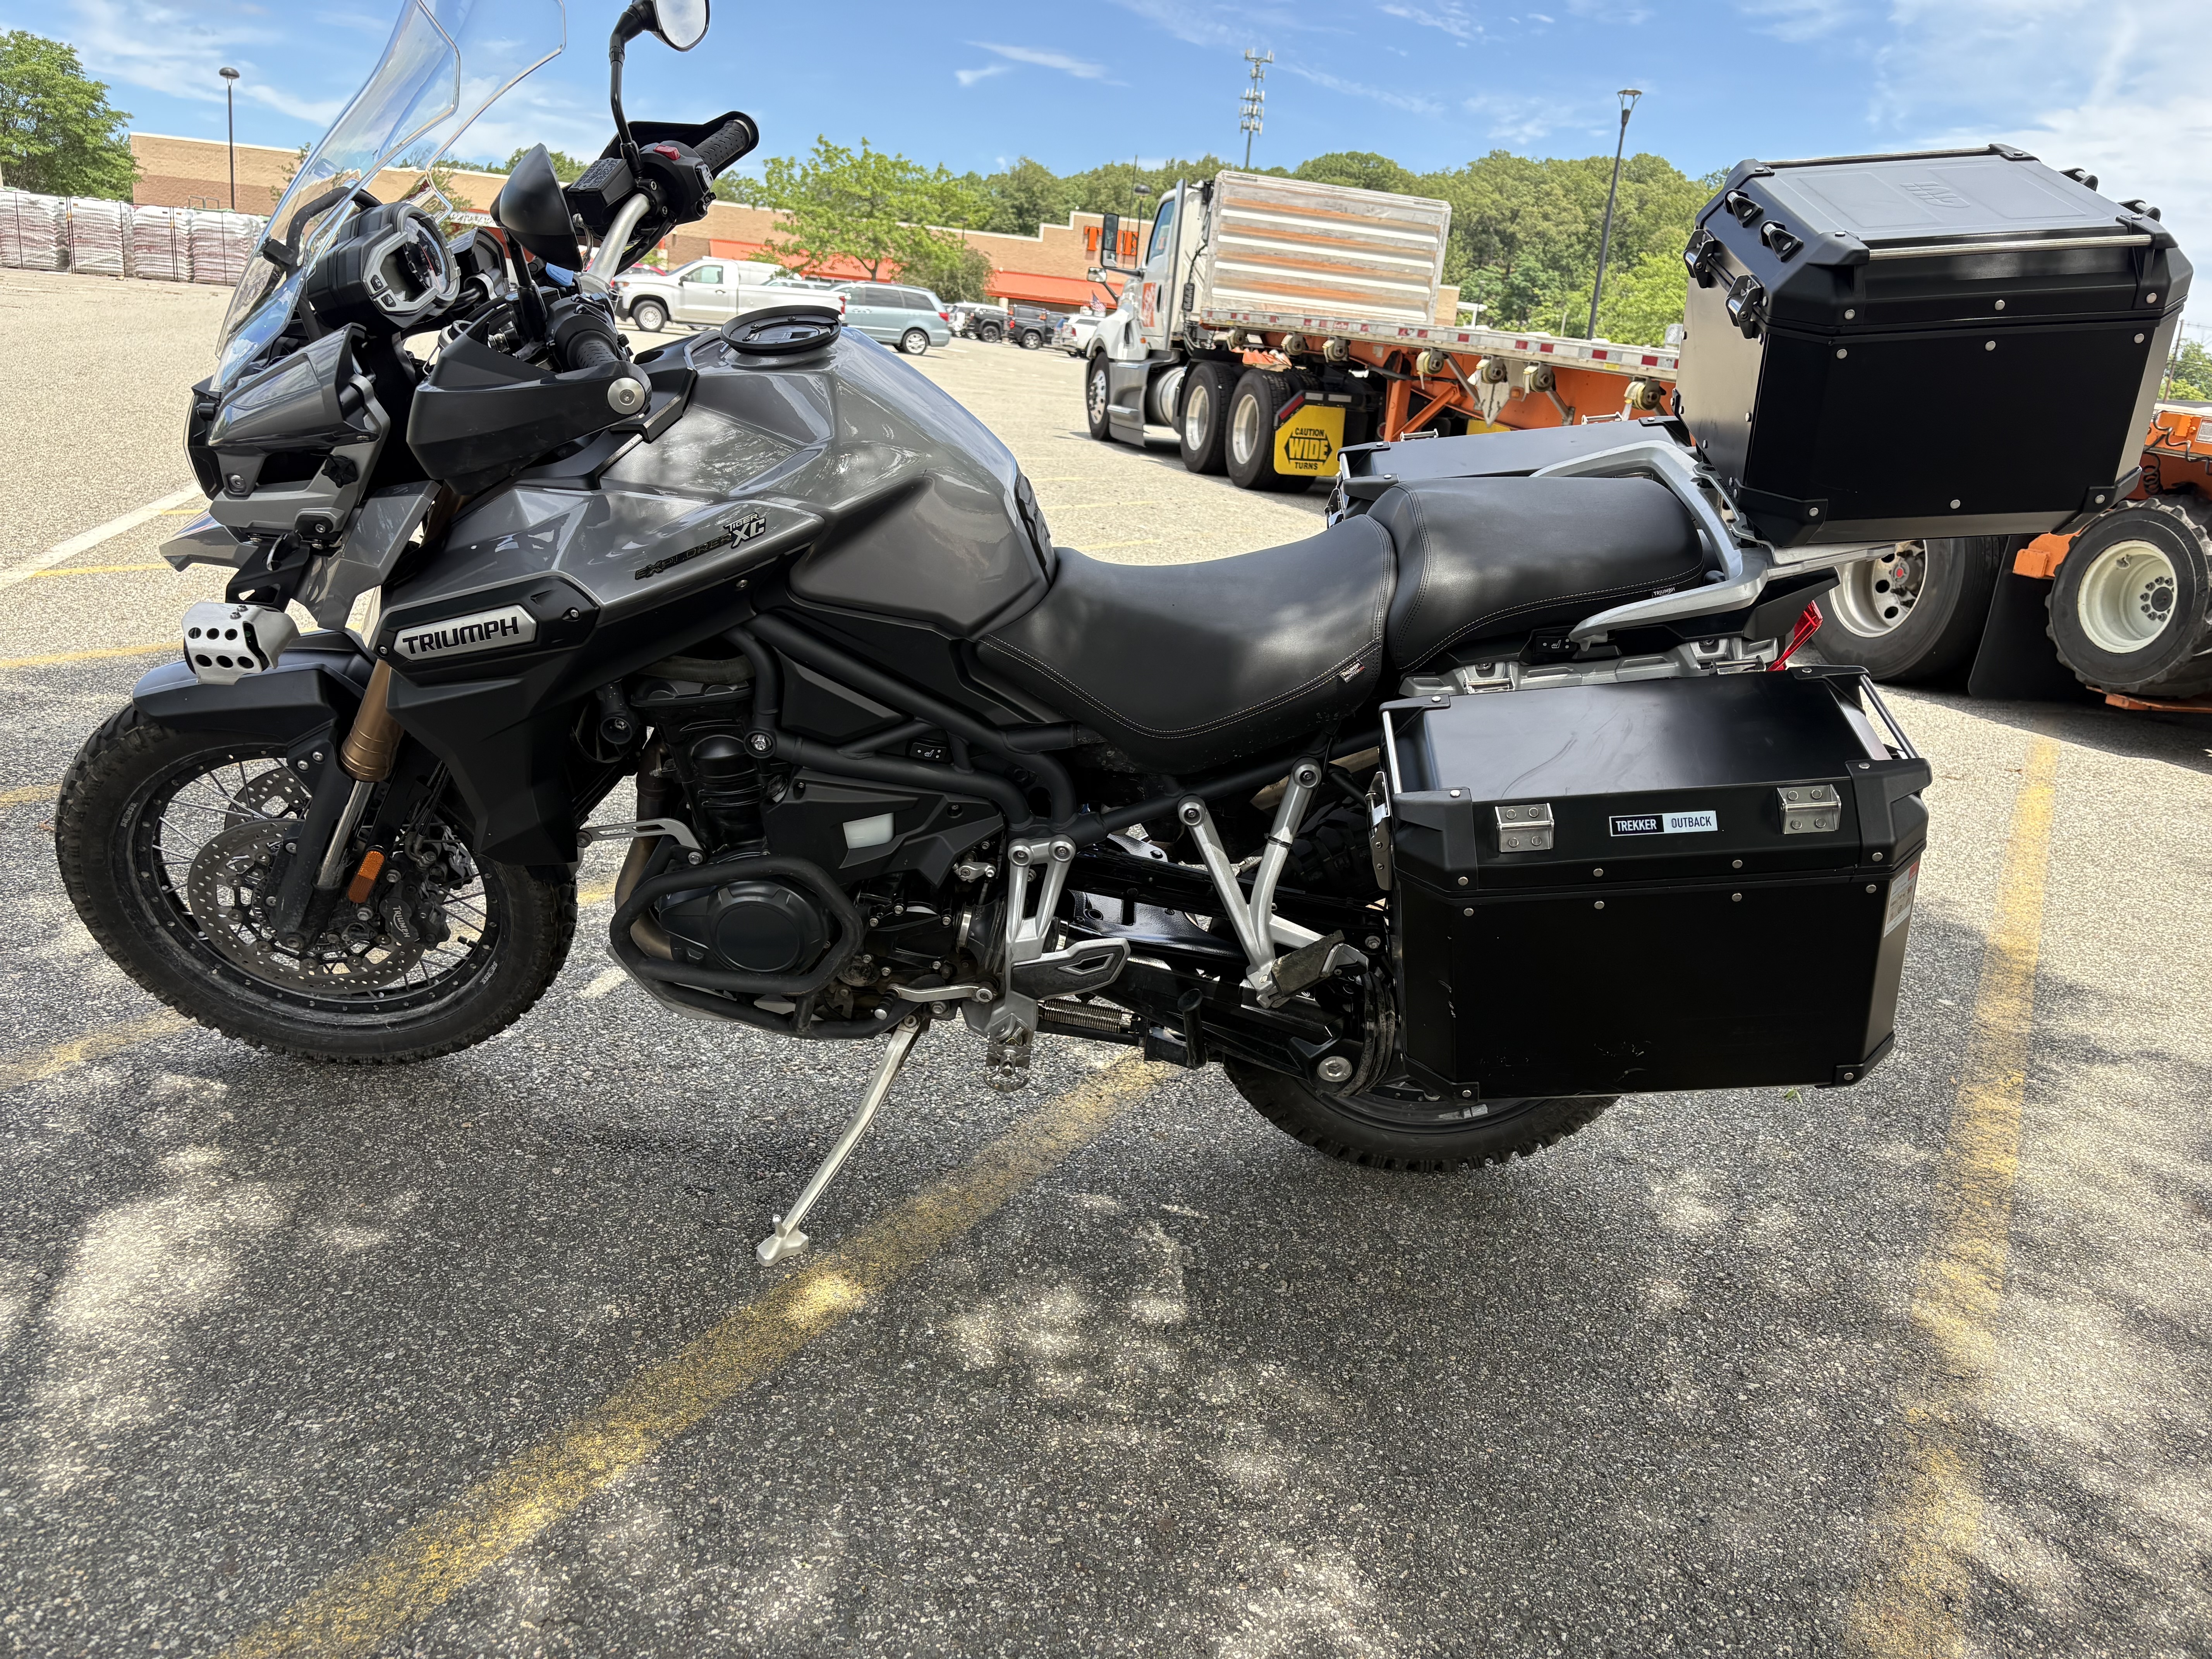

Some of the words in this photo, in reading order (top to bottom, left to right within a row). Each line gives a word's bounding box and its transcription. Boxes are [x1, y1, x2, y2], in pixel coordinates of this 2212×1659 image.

[1295, 428, 1324, 437] CAUTION
[1289, 438, 1328, 460] WIDE
[1295, 462, 1318, 470] TURNS
[725, 513, 760, 532] TIGER
[732, 518, 766, 547] XC
[635, 533, 732, 579] EXPLORER
[1653, 587, 1675, 596] TRIUMPH
[402, 617, 519, 654] TRIUMPH
[1341, 663, 1360, 677] TRIUMPH
[1616, 819, 1657, 832] TREKKER
[1671, 816, 1712, 828] OUTBACK
[393, 904, 410, 938] TRIUMPH
